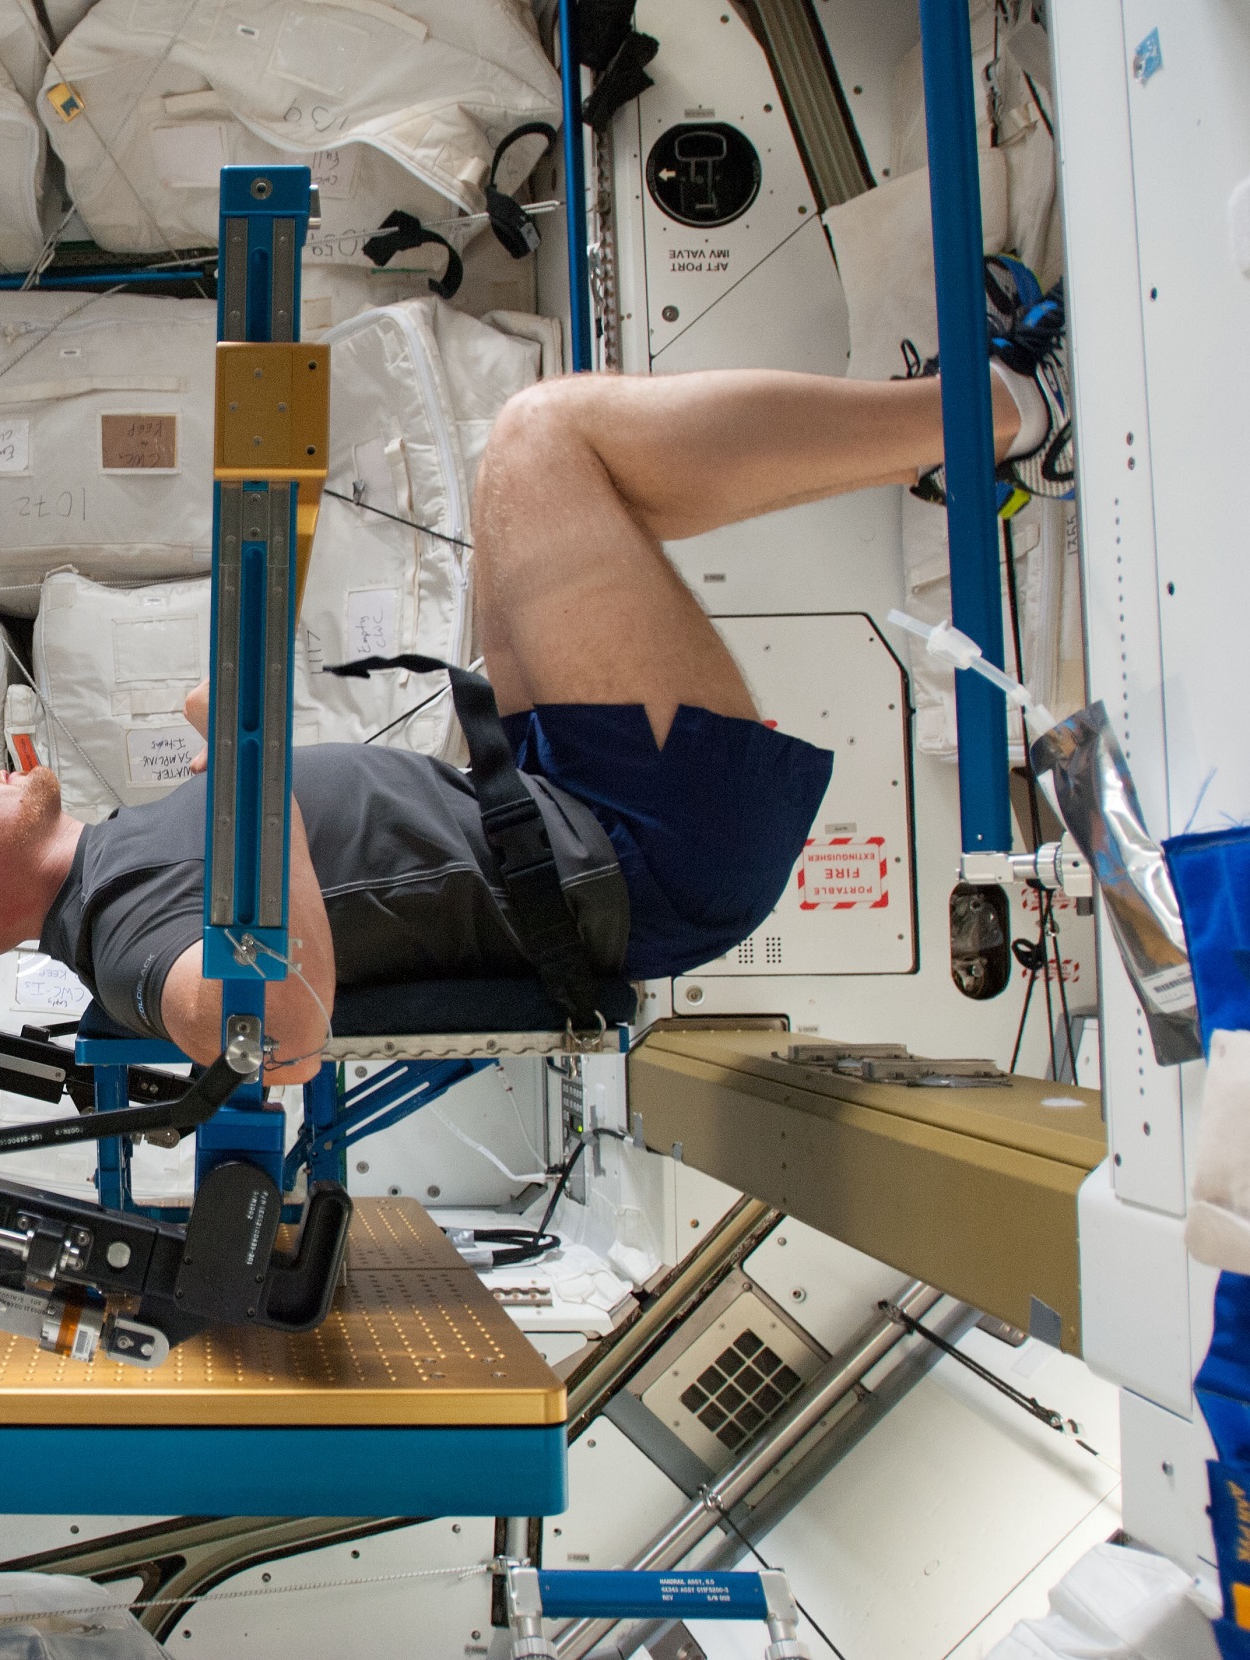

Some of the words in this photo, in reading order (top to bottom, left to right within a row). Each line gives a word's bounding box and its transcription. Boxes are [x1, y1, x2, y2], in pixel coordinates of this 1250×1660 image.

[668, 249, 706, 259] VALVE
[709, 249, 730, 259] IMV
[670, 262, 703, 272] PORT
[706, 262, 729, 272] AFT
[17, 488, 86, 521] 1072
[355, 615, 372, 653] Empty
[152, 766, 193, 781] WATER
[807, 852, 875, 862] EXTINGUISHER
[824, 867, 860, 880] FIRE
[813, 886, 873, 896] PORTABLE
